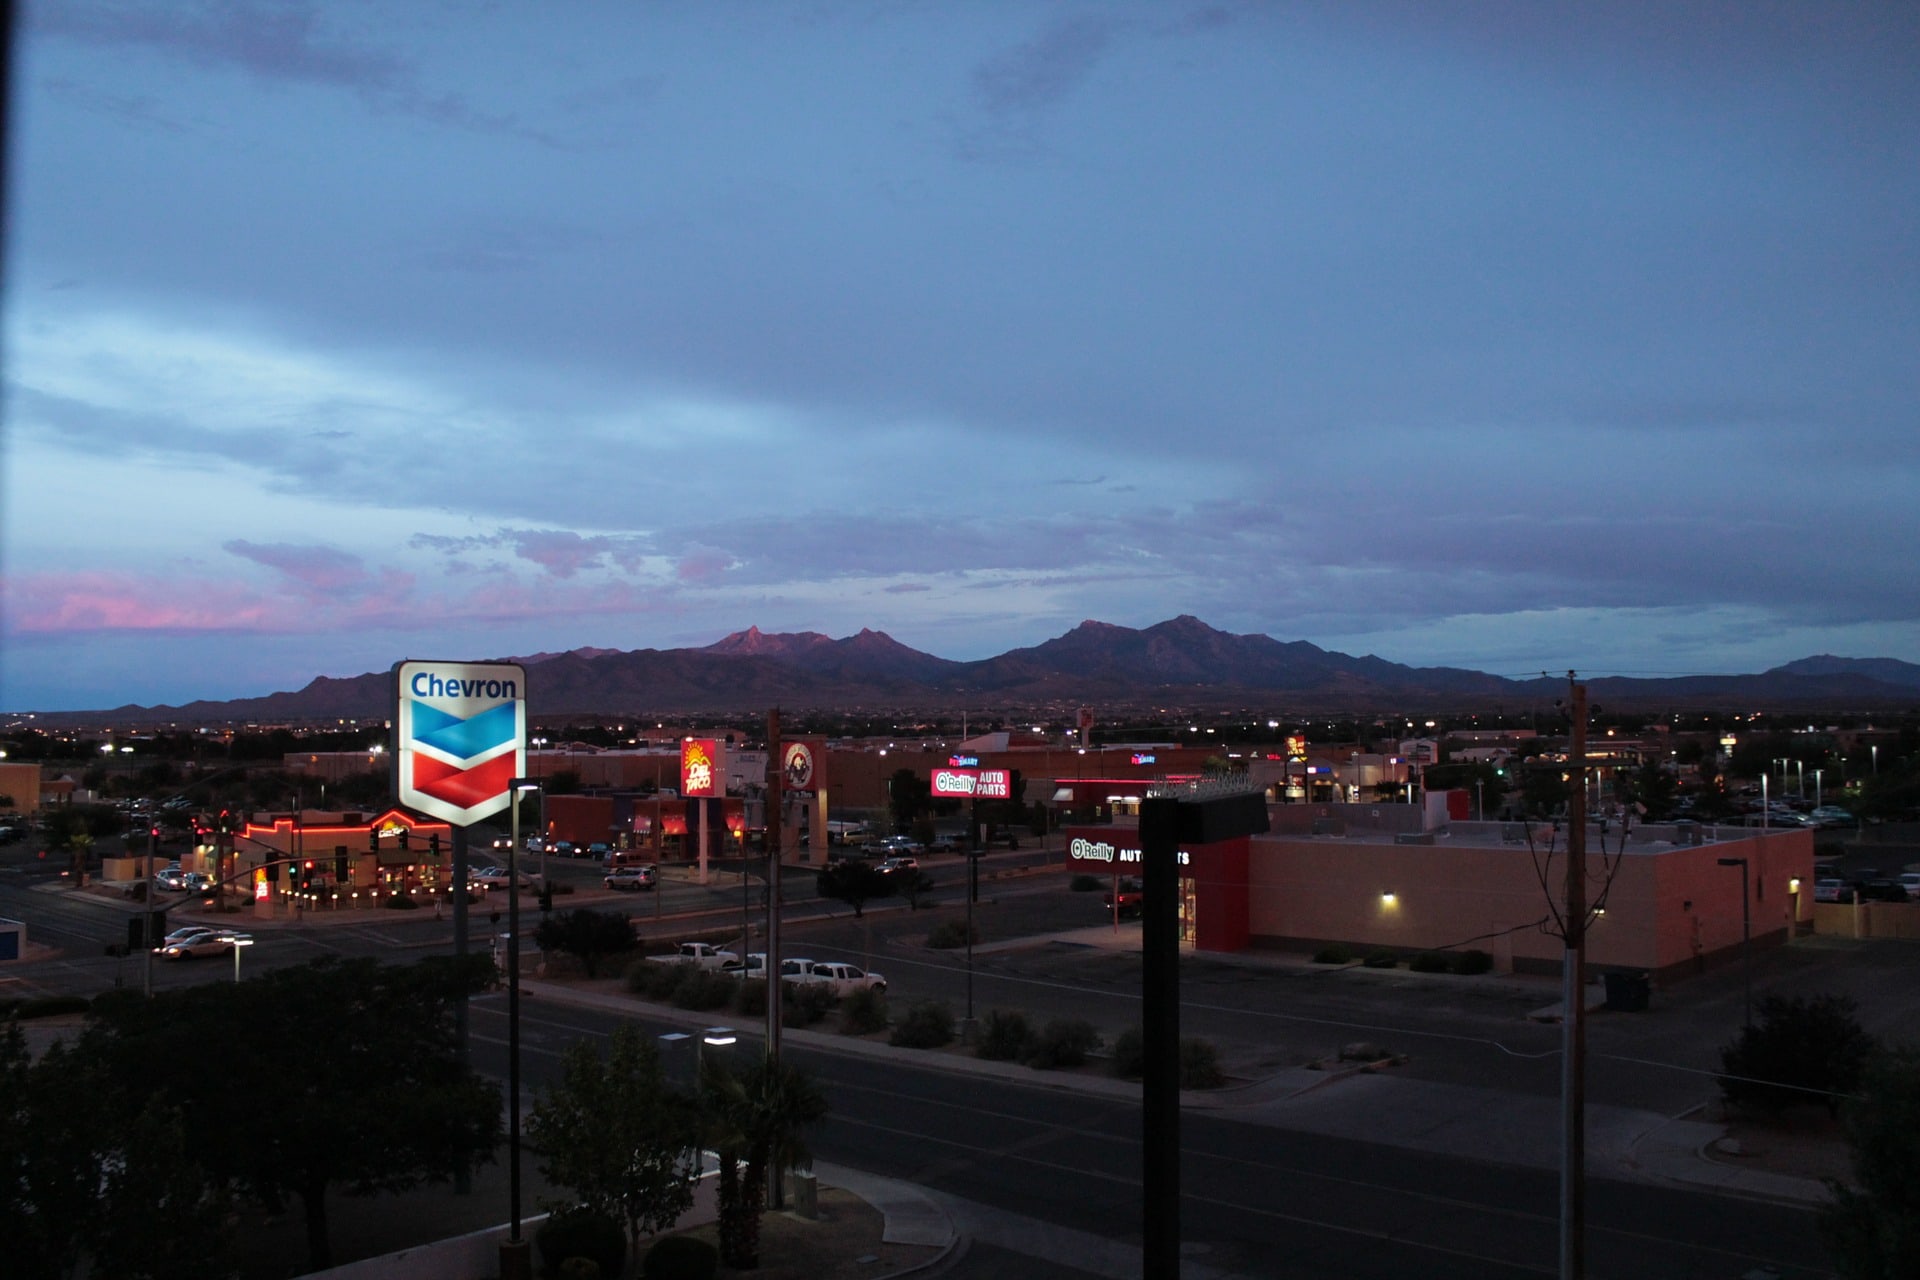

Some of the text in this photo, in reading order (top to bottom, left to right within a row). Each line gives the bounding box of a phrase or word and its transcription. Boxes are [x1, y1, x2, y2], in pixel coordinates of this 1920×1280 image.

[411, 672, 516, 698] Chevron
[689, 763, 711, 779] DEL
[686, 776, 711, 794] TACO
[936, 771, 1004, 794] O'Reilly AUTO
[977, 784, 1006, 796] PARTS
[1071, 838, 1144, 863] O'Reilly AUT
